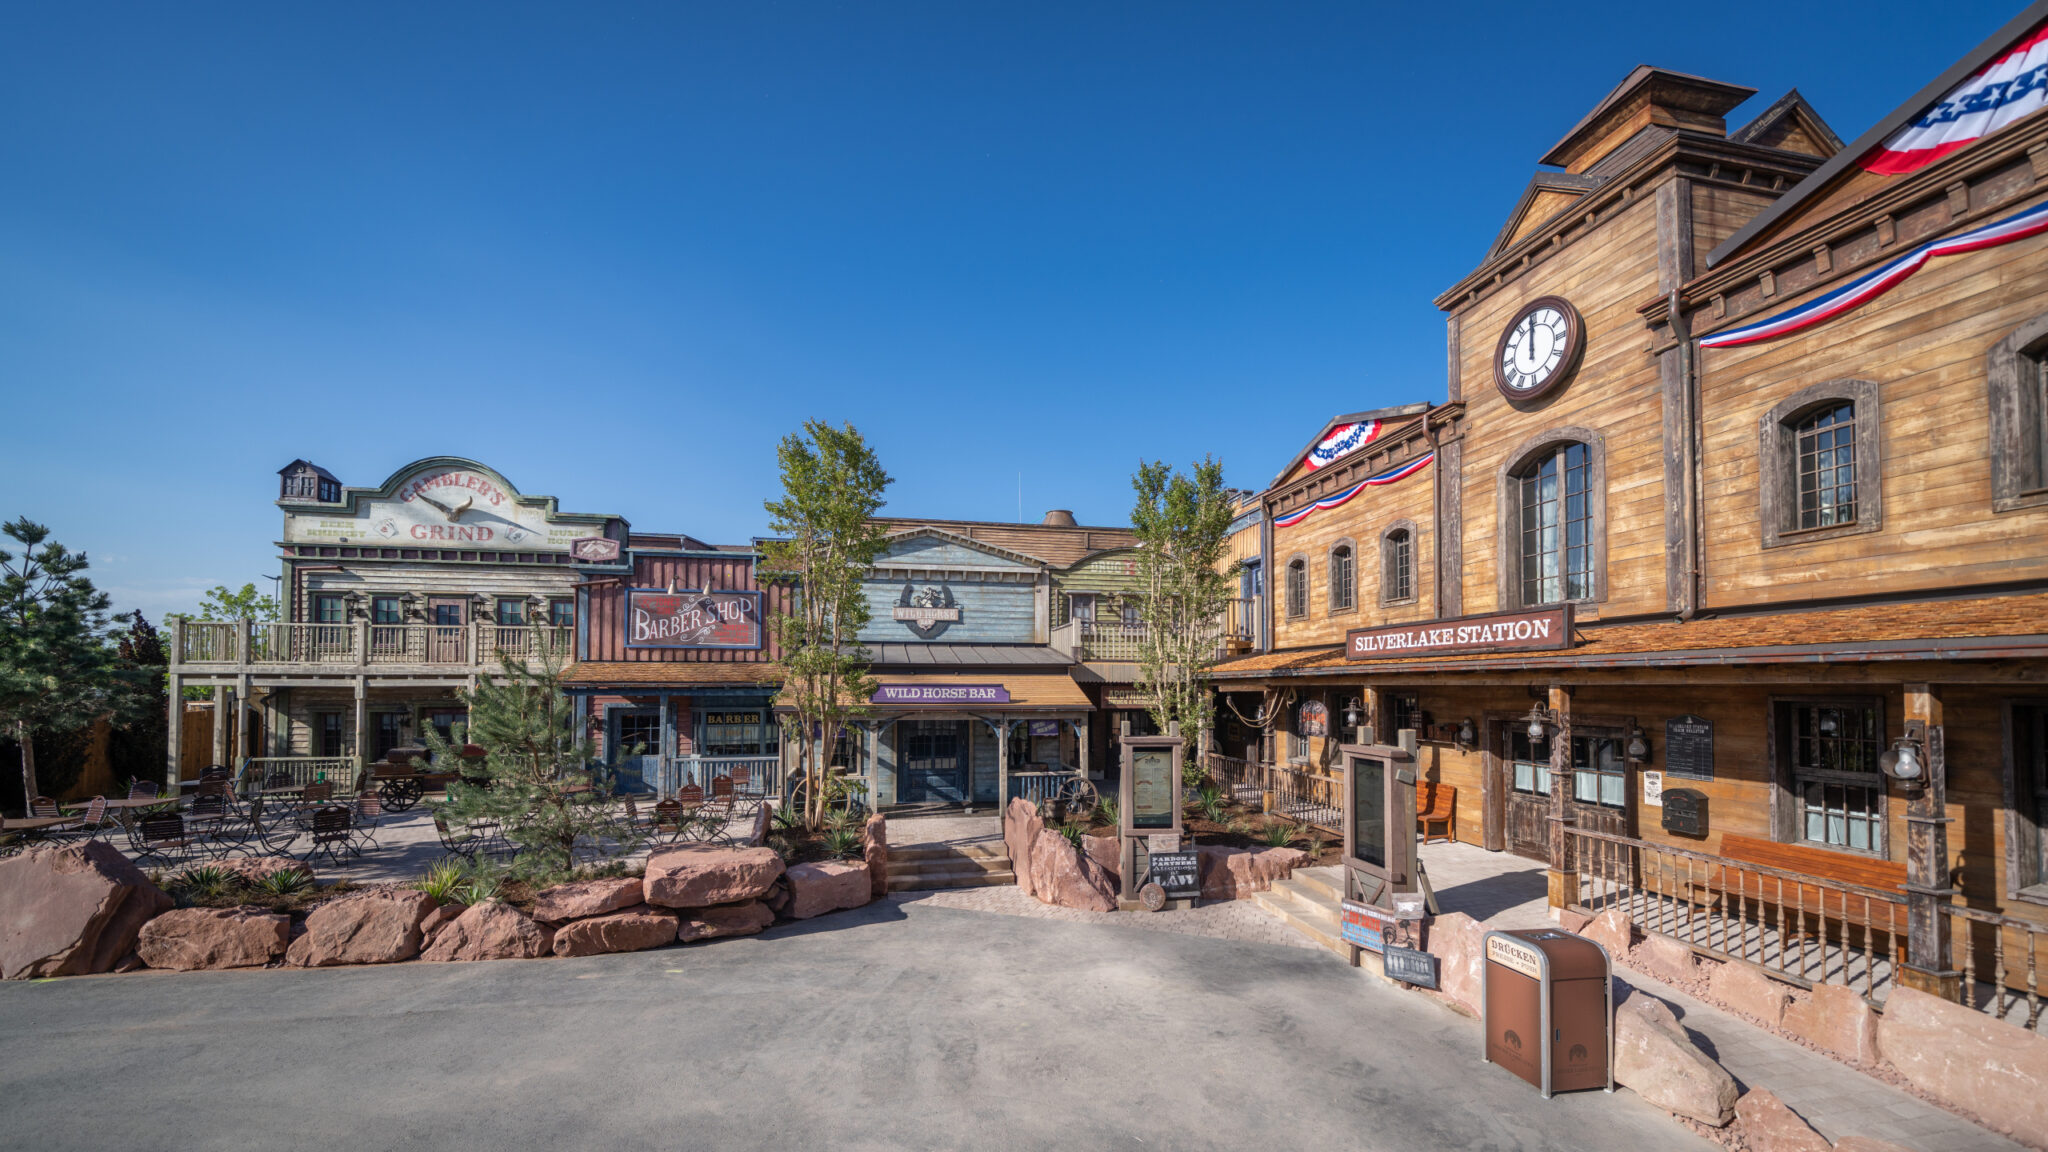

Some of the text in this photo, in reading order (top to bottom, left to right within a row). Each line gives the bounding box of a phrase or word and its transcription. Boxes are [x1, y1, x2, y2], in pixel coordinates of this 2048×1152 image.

[400, 473, 506, 506] GAMBLER'S
[410, 524, 494, 541] GRIND
[635, 597, 752, 641] BARBER SHOP
[896, 609, 956, 619] WILD HORSE
[1355, 618, 1551, 652] SILVERLAKE STATION
[884, 688, 996, 699] WILD HORSE BAR
[708, 714, 760, 724] BARBER
[1153, 874, 1196, 887] LAW
[1491, 940, 1537, 966] DRÜCKEN
